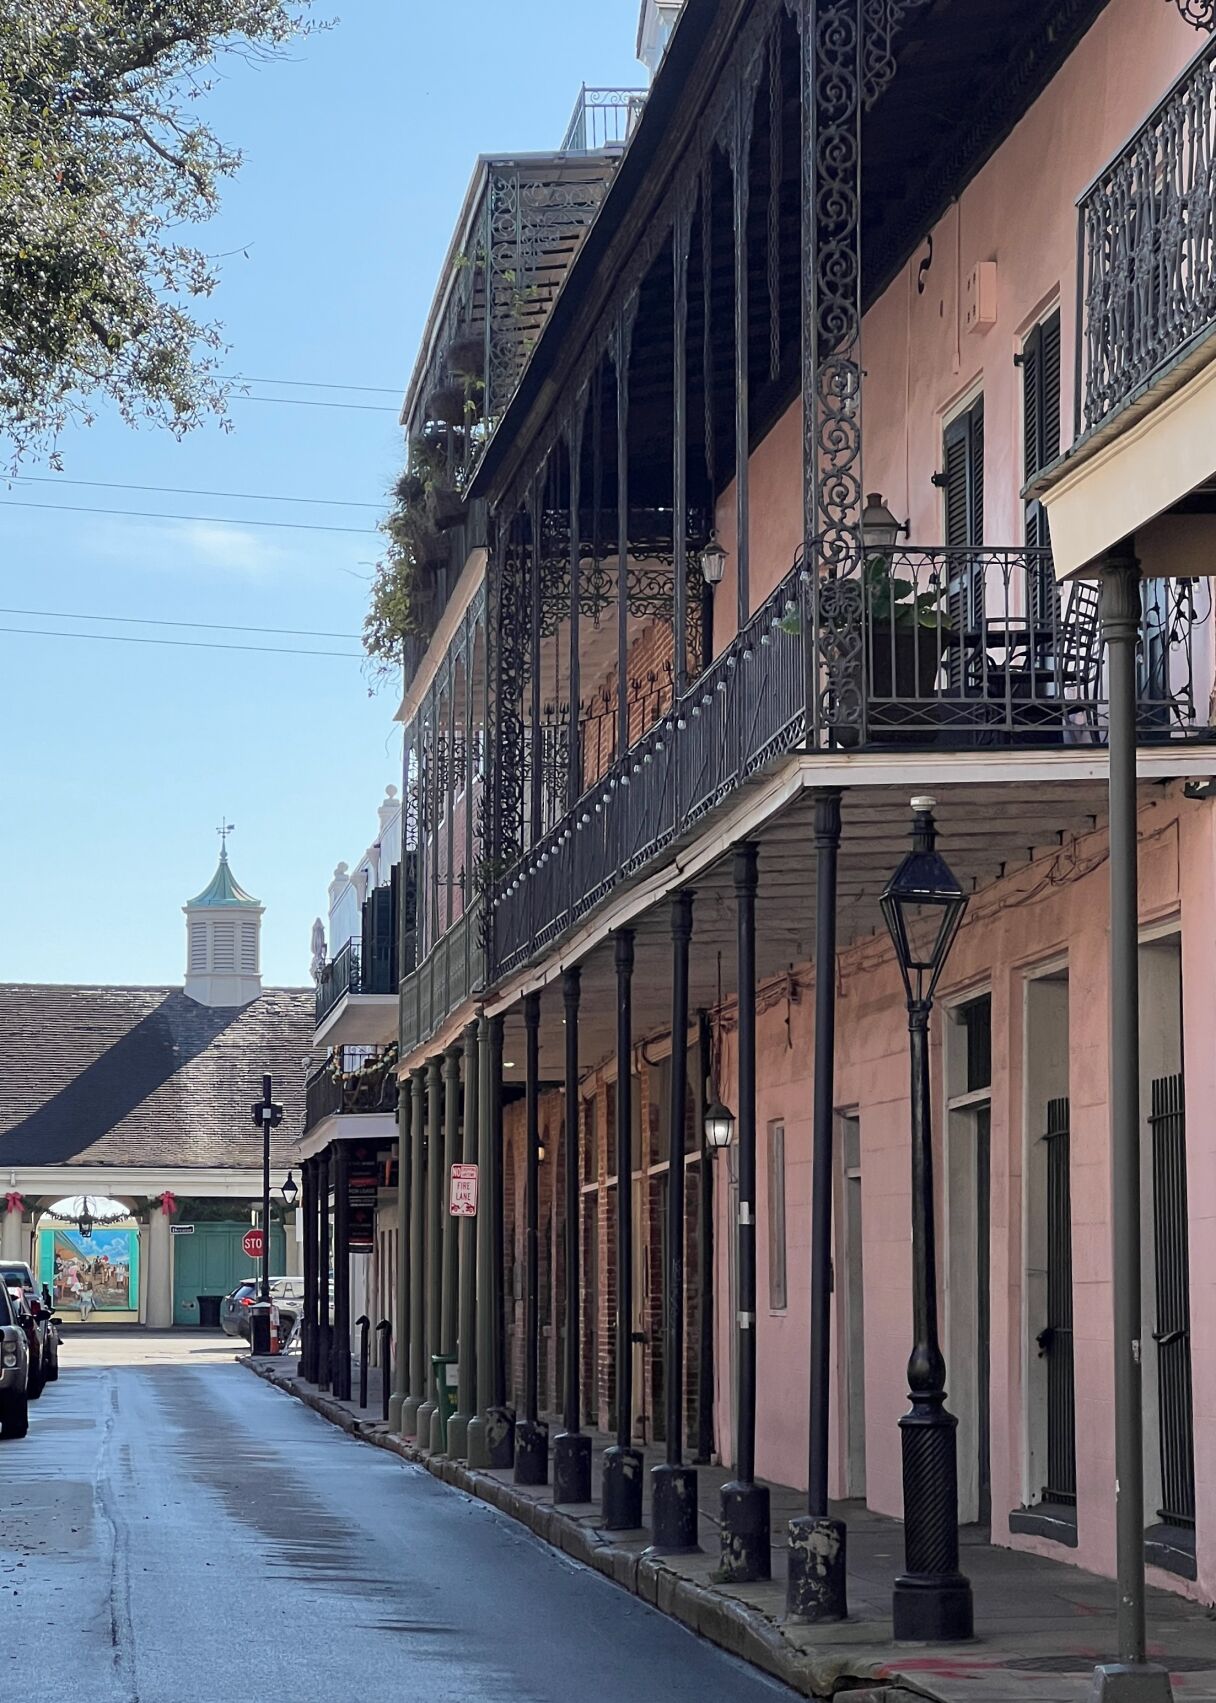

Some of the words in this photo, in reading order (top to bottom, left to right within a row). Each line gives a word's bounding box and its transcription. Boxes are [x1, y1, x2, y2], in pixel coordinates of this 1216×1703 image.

[453, 1167, 461, 1178] NO
[457, 1182, 471, 1191] FIRE
[244, 1238, 262, 1248] STO
